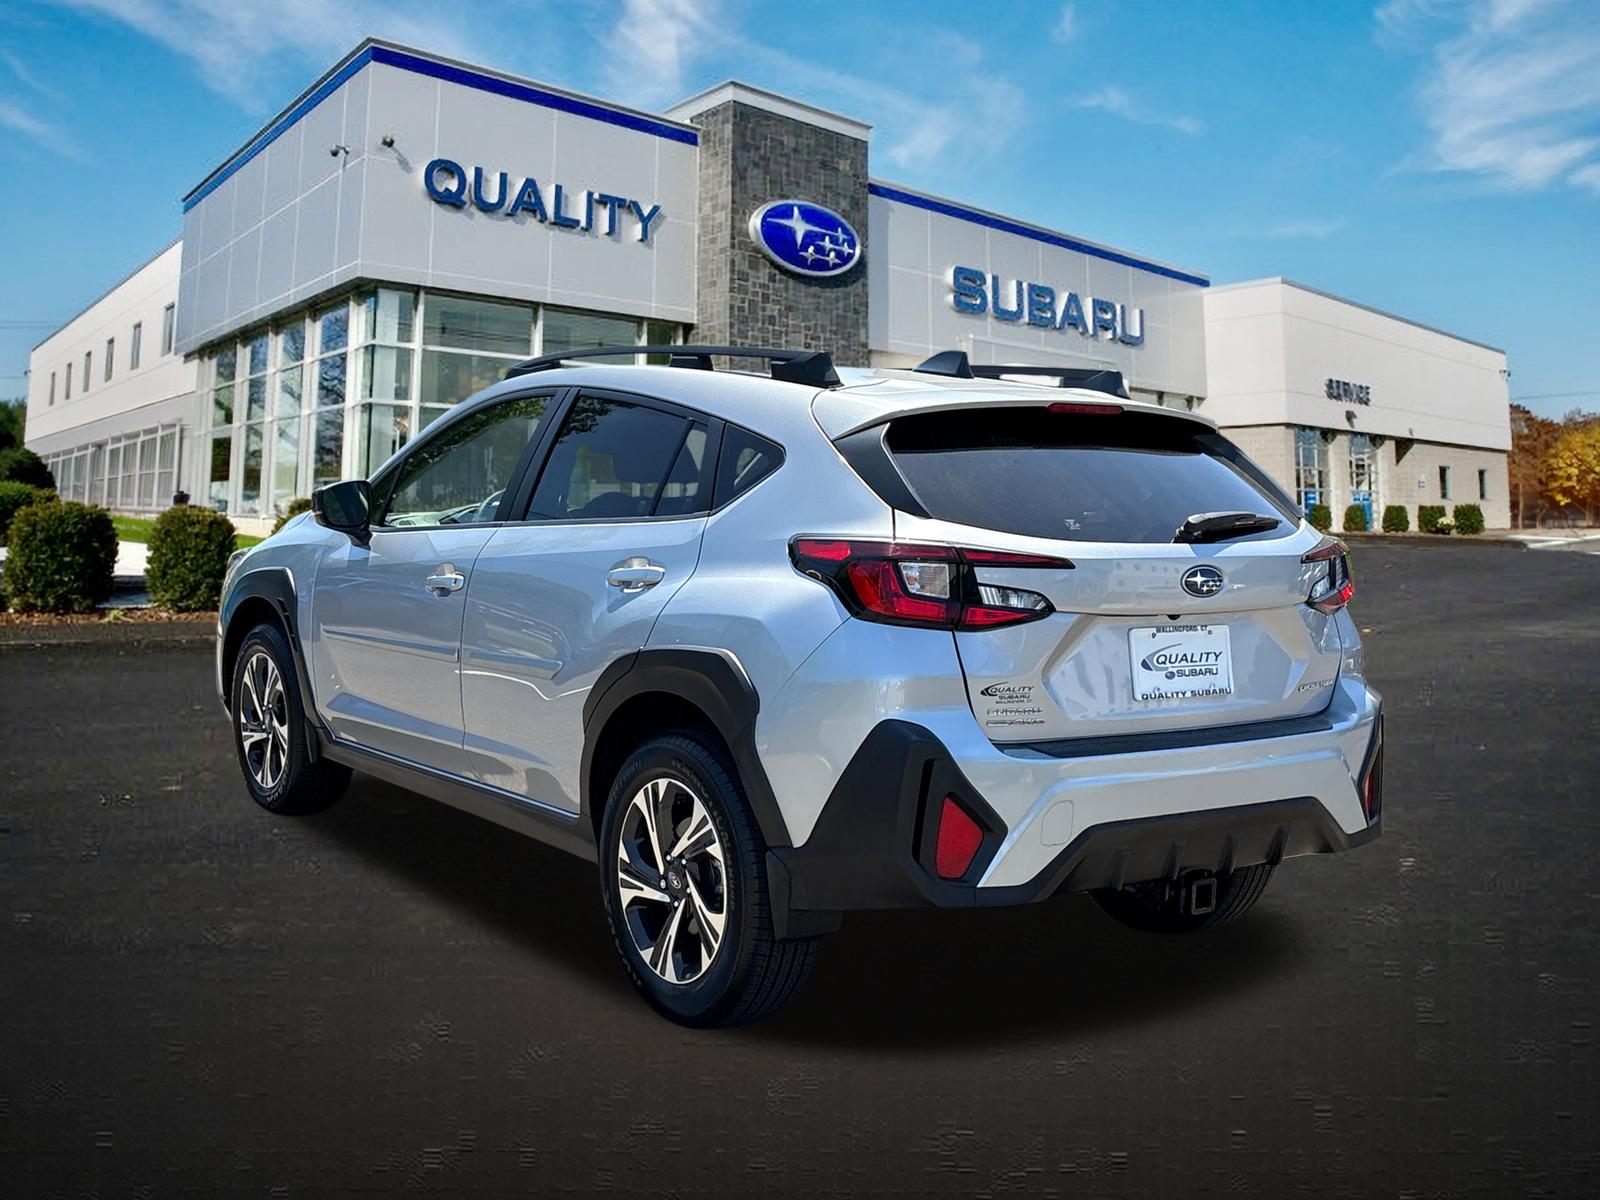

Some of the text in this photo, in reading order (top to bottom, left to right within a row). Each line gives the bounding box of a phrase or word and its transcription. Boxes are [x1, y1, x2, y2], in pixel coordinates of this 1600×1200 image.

[423, 158, 662, 243] QUALITY
[950, 265, 1145, 346] SUBARU
[1156, 651, 1223, 665] QUALITY
[1176, 667, 1219, 678] SUBARU
[1141, 687, 1232, 701] QUALITY SUBARU
